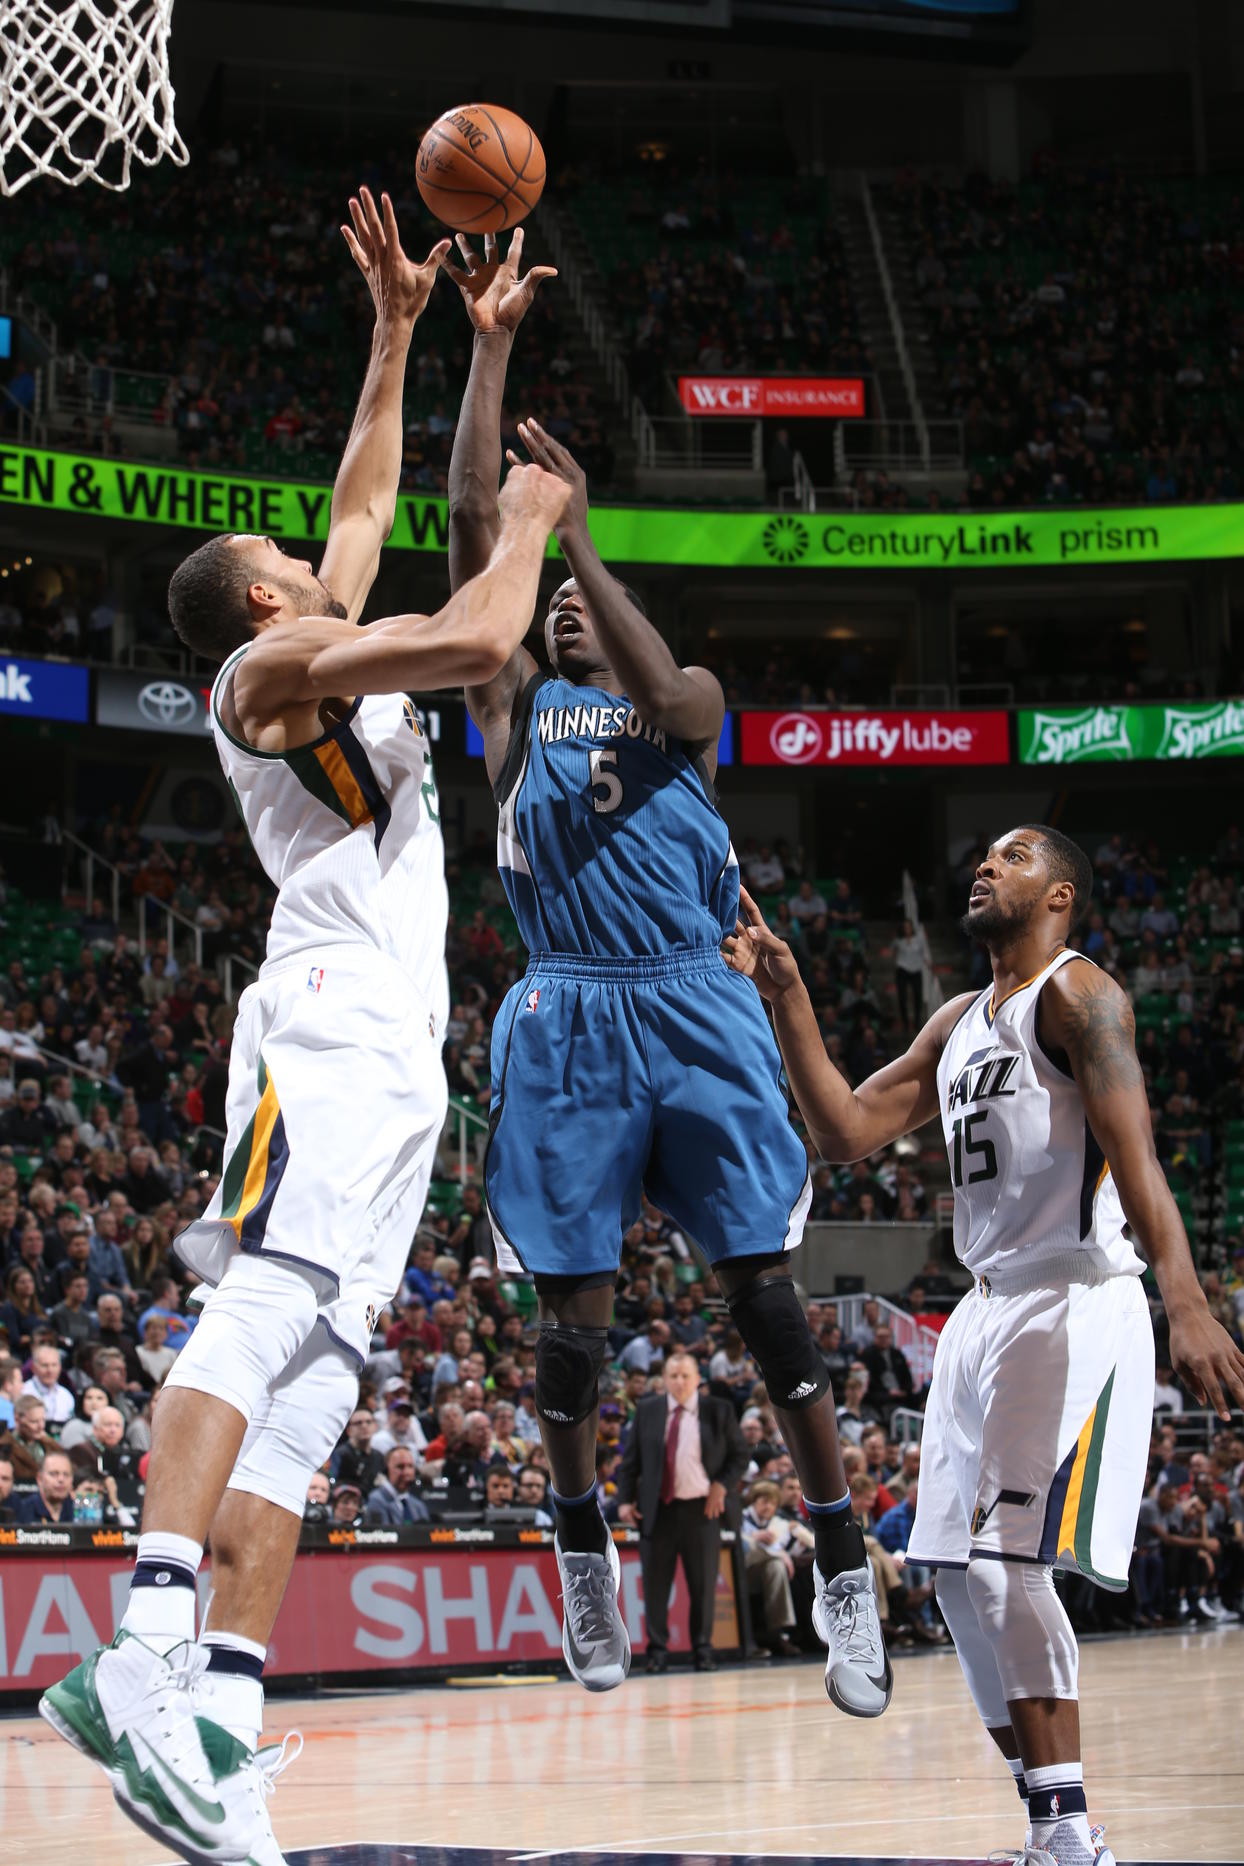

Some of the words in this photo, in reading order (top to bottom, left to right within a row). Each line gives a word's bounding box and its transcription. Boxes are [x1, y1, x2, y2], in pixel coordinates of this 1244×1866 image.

[692, 384, 760, 409] WCF
[766, 389, 858, 407] INSURANCE
[68, 462, 103, 511] &
[115, 467, 283, 532] WHERE
[822, 524, 1035, 562] CenturyLink
[1059, 521, 1160, 559] prism
[827, 718, 901, 759] jiffy
[903, 718, 973, 751] lube
[1037, 706, 1118, 764] Sprite
[590, 750, 624, 814] 5
[952, 1109, 998, 1188] 15
[350, 1564, 677, 1659] SHAP
